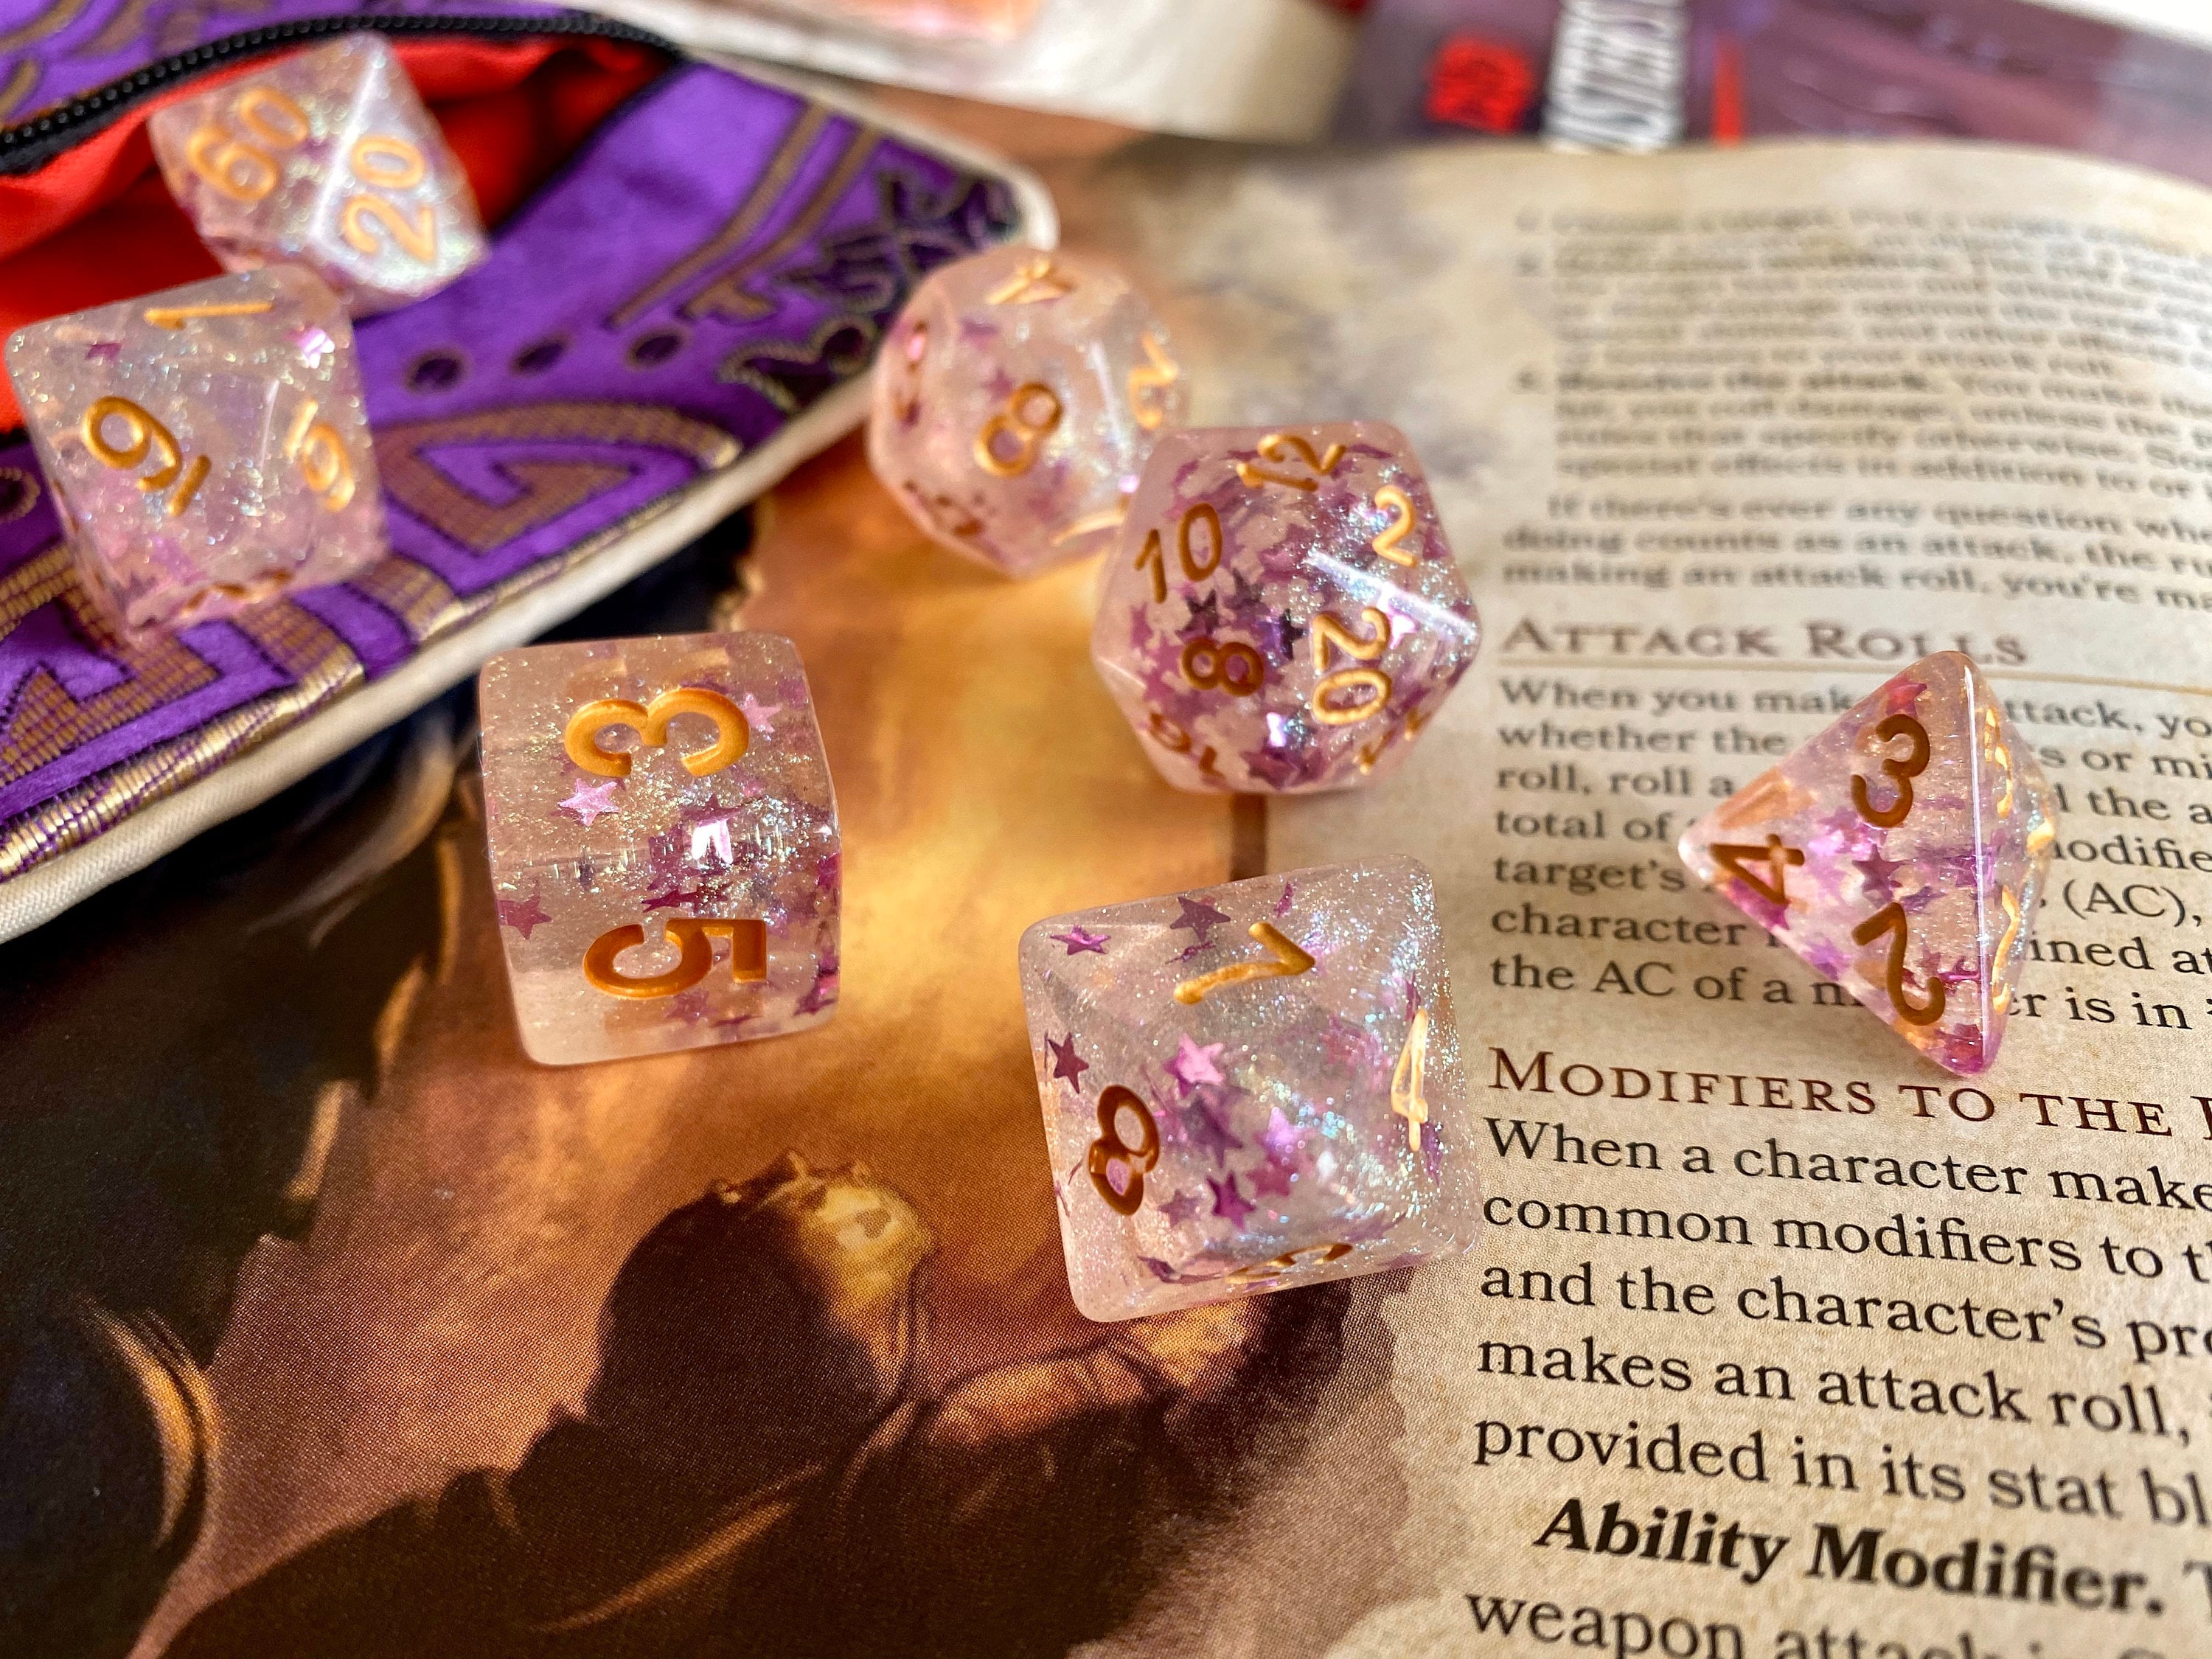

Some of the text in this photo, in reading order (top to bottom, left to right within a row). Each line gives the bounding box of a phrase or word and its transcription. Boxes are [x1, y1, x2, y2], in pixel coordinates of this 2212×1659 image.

[188, 86, 310, 201] 60
[343, 135, 439, 264] 20
[975, 381, 1064, 478] 8
[1237, 434, 1348, 492] 12
[1135, 503, 1222, 603] 10
[1371, 484, 1418, 568] 2
[1793, 529, 1843, 554] as
[1855, 534, 1908, 556] an
[2084, 540, 2159, 571] the
[1846, 499, 1919, 527] any
[1502, 560, 1671, 592] making
[1683, 565, 1738, 587] an
[1751, 562, 1885, 588] attack
[2000, 570, 2140, 605] you're
[1182, 639, 1265, 698] 8
[1311, 606, 1393, 725] 20
[1500, 616, 1778, 659] ATTACK
[564, 687, 750, 777] 3
[1497, 720, 1696, 754] whether
[1712, 725, 1788, 756] the
[2081, 748, 2133, 772] or
[1500, 677, 1641, 710] When
[1651, 684, 1737, 718] you
[1753, 684, 1855, 714] mak
[2003, 698, 2145, 733] ttack,
[1496, 762, 1593, 796] roll,
[1609, 765, 1693, 796] roll
[1708, 775, 1736, 797] a
[2087, 786, 2171, 821] the
[1851, 714, 1930, 828] 3
[1496, 809, 1608, 840] total
[1623, 811, 1674, 842] of
[1494, 856, 2202, 928] target's (AC),
[1710, 833, 1805, 905] 4
[582, 918, 768, 999] 5
[1174, 921, 1316, 1006] 7
[1491, 902, 1747, 947] character
[1852, 902, 1947, 1026] 2
[1491, 953, 1575, 991] the
[1593, 960, 1676, 998] AC
[1692, 965, 1748, 1001] of
[1762, 978, 1798, 1004] a
[2065, 987, 2116, 1024] is
[2130, 991, 2194, 1031] in
[1391, 1008, 1430, 1152] 4
[1488, 1047, 1878, 1116] MODIFIERS
[1896, 1084, 1996, 1123] TO
[2019, 1091, 2174, 1138] THE
[1088, 1085, 1161, 1217] 8
[1484, 1118, 2212, 1212] When a character make
[1482, 1196, 1753, 1247] common
[1772, 1214, 2083, 1273] modifiers
[2098, 1236, 2163, 1279] to
[1481, 1262, 1596, 1307] and
[1615, 1266, 1717, 1316] the
[1737, 1276, 2107, 1350] character's
[1475, 1336, 2191, 1448] makes an attack roll,
[1473, 1417, 1770, 1484] provided
[1790, 1436, 1859, 1493] in
[1880, 1444, 1966, 1505] its
[1988, 1463, 2124, 1521] stat
[1532, 1496, 1791, 1585] Ability
[1806, 1522, 2166, 1619] Modifier.
[1464, 1592, 1746, 1659] weapon
